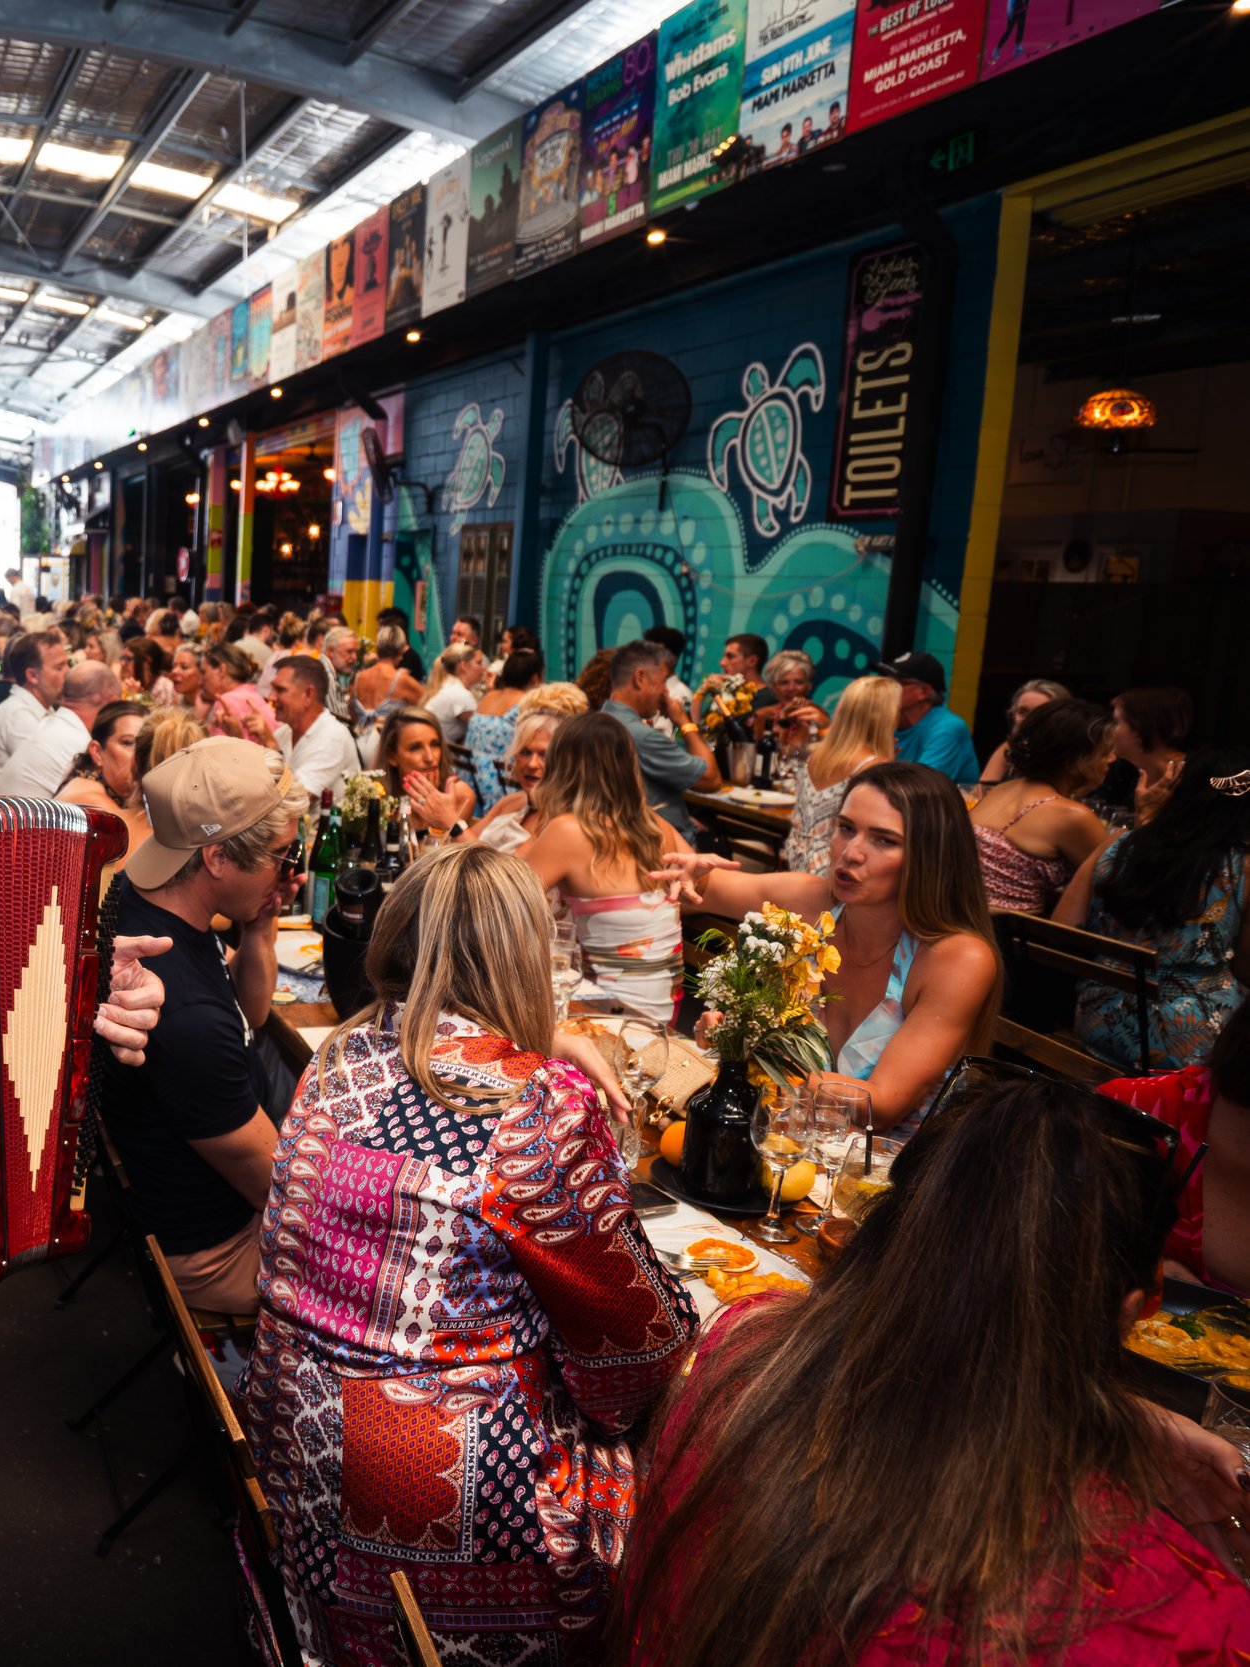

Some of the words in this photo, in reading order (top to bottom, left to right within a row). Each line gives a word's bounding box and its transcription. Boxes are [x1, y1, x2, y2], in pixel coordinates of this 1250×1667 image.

[880, 7, 906, 34] BEST
[907, 0, 922, 20] OF
[909, 29, 929, 45] NOV
[863, 58, 898, 84] MIAMI
[899, 28, 968, 68] MARKETTA,
[874, 70, 907, 95] GOLD
[908, 51, 951, 80] COAST
[668, 82, 692, 108] Bob
[751, 87, 781, 115] MIAMI
[781, 59, 837, 100] MARKETTA
[843, 341, 914, 507] TOILETS
